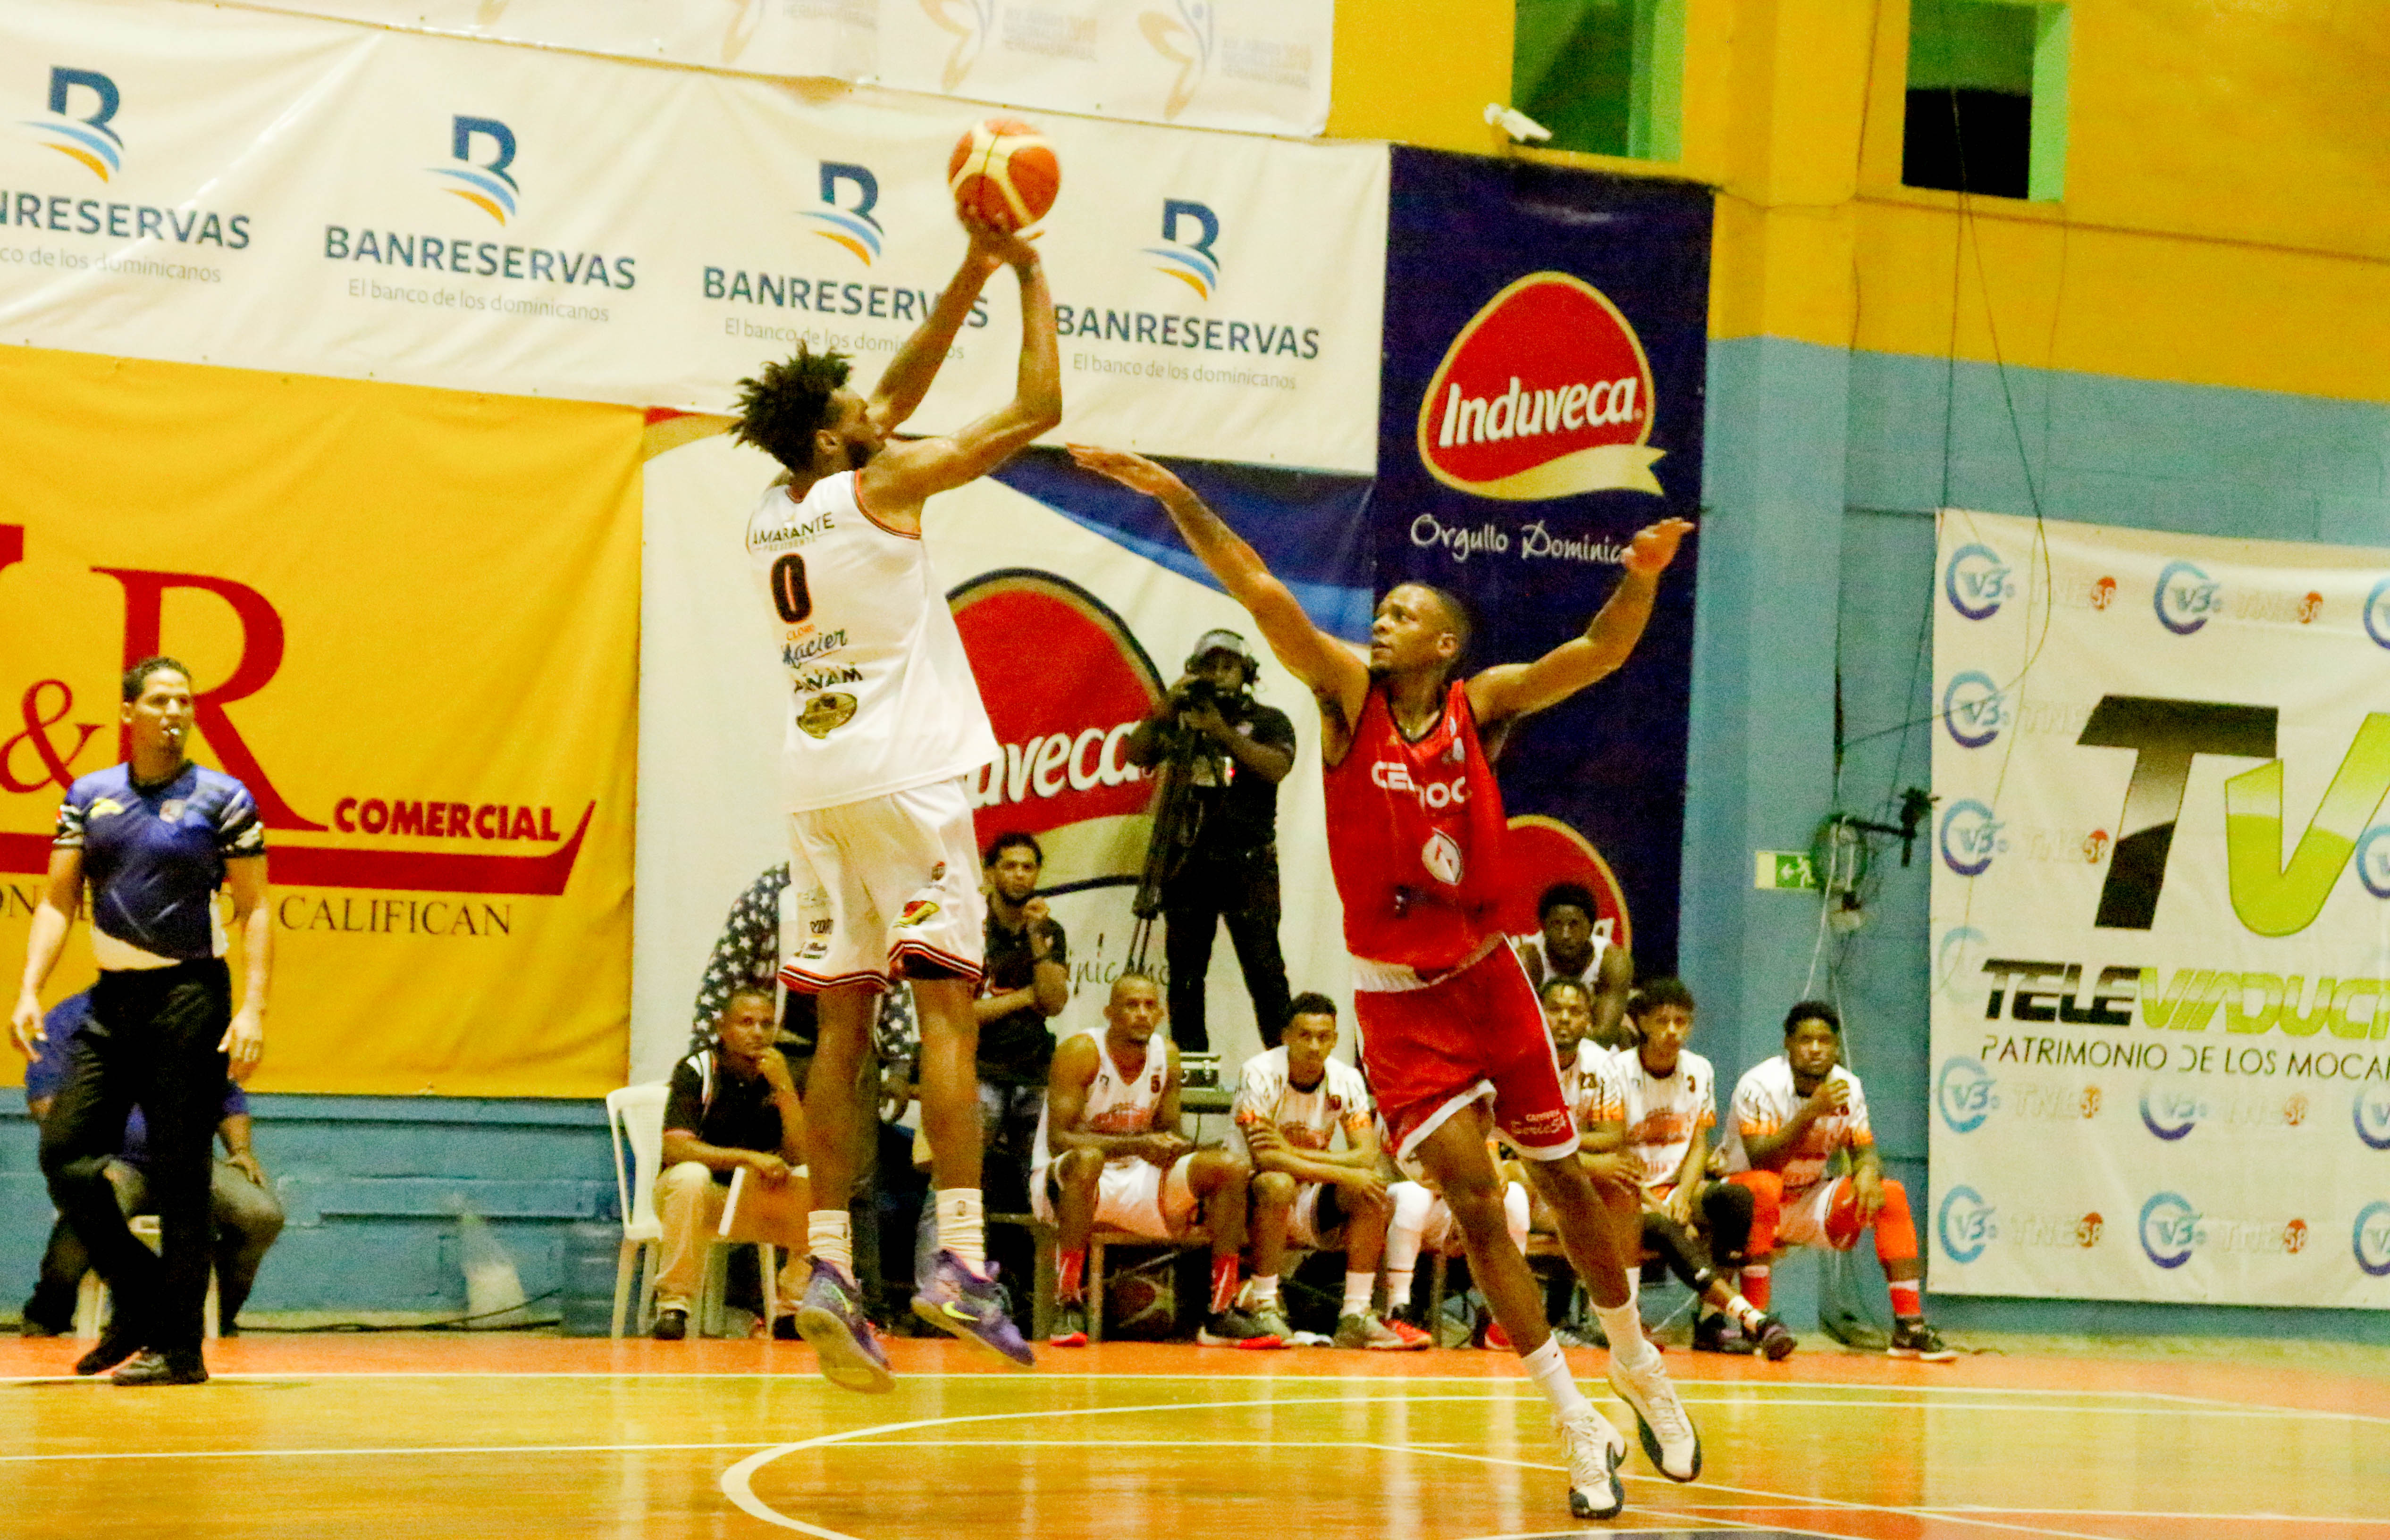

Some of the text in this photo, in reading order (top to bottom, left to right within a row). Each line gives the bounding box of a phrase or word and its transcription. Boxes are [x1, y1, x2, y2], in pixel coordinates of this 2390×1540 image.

[30, 247, 54, 268] de
[59, 249, 89, 270] los
[95, 253, 222, 283] dominicanos
[324, 224, 636, 290] BANRESERVAS
[348, 278, 610, 322] El banco de los dominicanos
[703, 265, 989, 329] BANRESERVS
[724, 317, 740, 335] El
[744, 319, 795, 342] banco
[802, 324, 821, 344] de
[825, 326, 849, 350] los
[1054, 303, 1320, 360] BANRESERVAS
[1073, 354, 1296, 389] El banco de los dominicanos
[1438, 376, 1638, 448] Induveca
[1410, 513, 1508, 562] Orgullo
[770, 553, 813, 625] 0
[966, 720, 1140, 809] uveca
[333, 797, 560, 842] COMERCIAL
[279, 895, 512, 937] CALIFICAN
[1981, 1035, 2168, 1070] PATRIMONIO
[2225, 1047, 2276, 1075] LOS
[2287, 1051, 2390, 1080] MOCA
